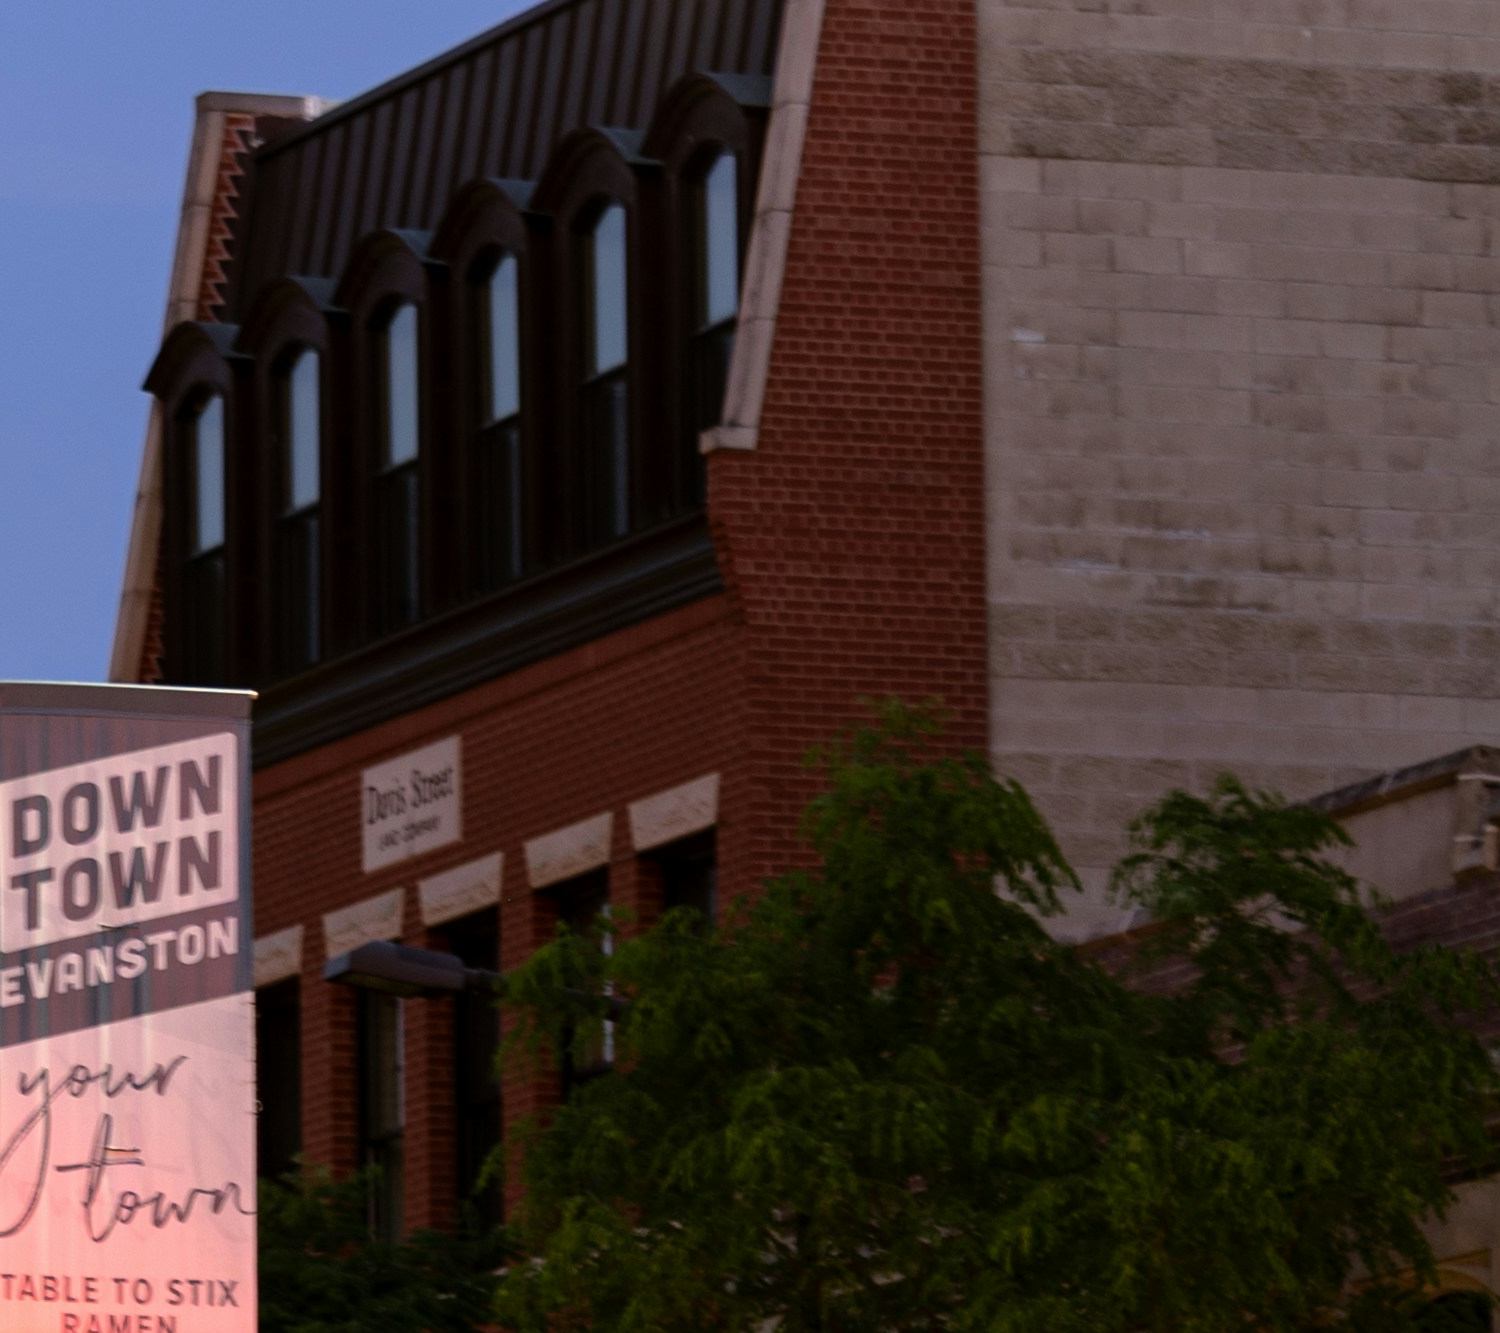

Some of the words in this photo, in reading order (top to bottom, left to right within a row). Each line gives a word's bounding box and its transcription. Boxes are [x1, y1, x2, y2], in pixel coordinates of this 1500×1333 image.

[10, 754, 222, 859] DOWN
[10, 829, 222, 932] TOWN
[55, 1113, 257, 1243] town
[0, 1272, 101, 1304] TABLE
[113, 1276, 155, 1305] TO
[166, 1278, 241, 1309] STIX
